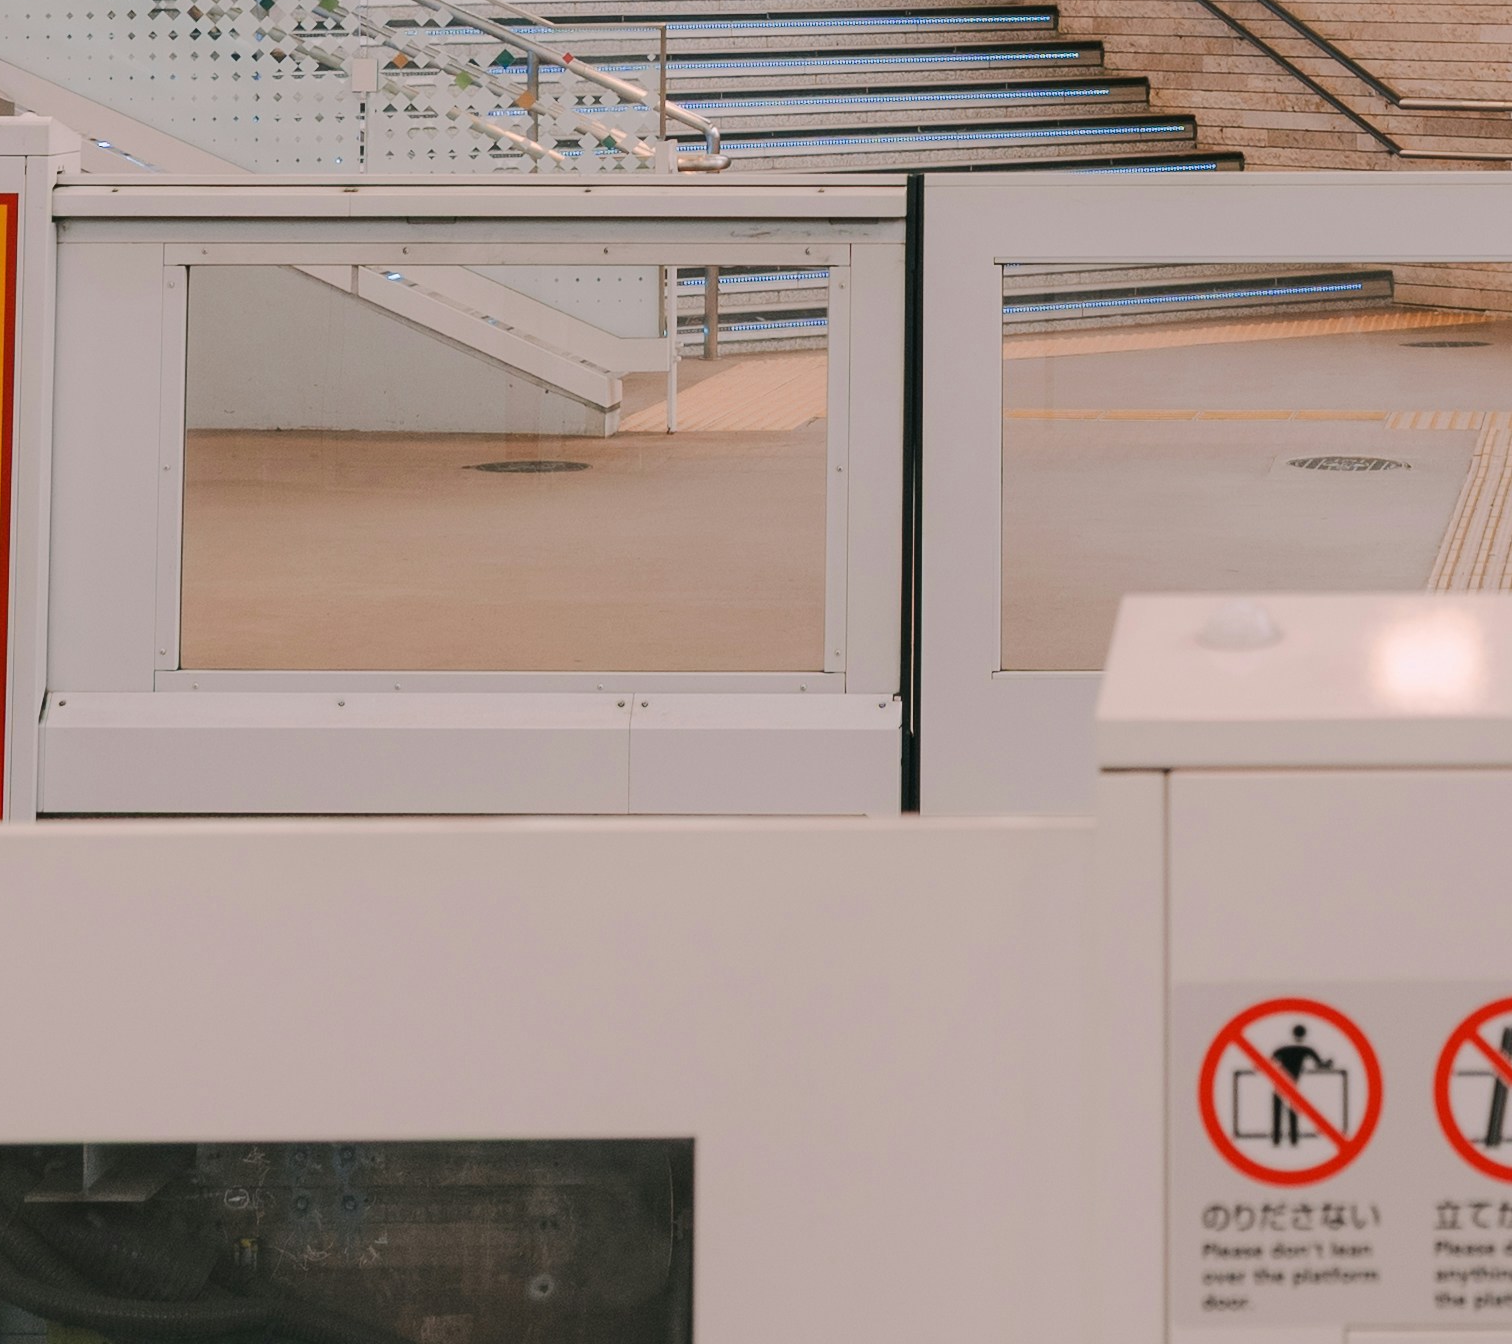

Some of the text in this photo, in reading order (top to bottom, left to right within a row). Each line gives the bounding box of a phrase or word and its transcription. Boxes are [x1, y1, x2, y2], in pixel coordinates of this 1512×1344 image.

[1201, 1202, 1381, 1231] のりださない
[1202, 1242, 1263, 1258] Please
[1331, 1242, 1373, 1258] lean
[1435, 1240, 1496, 1256] Please
[1202, 1268, 1379, 1287] over the platform
[1435, 1292, 1466, 1307] the
